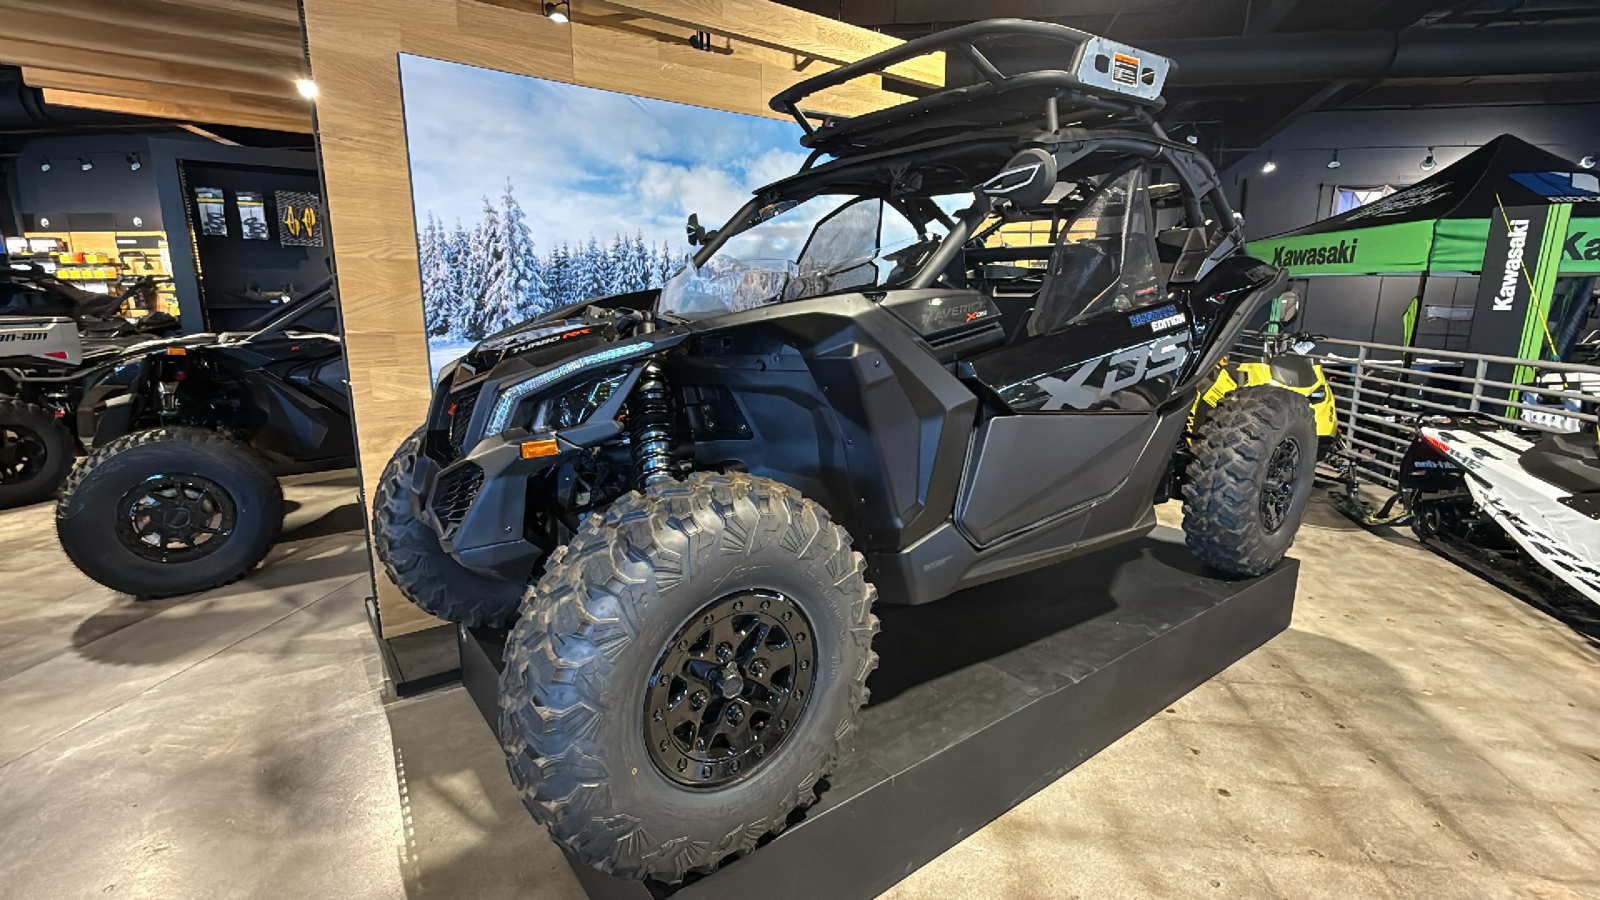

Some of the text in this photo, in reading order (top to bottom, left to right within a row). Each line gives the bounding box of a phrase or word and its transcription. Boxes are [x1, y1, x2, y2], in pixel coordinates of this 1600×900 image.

[1272, 238, 1358, 268] Kawasaki
[1492, 219, 1530, 311] Kawasaki
[1151, 312, 1186, 332] EDITION
[511, 335, 561, 354] TURBO
[1034, 330, 1189, 411] XDS
